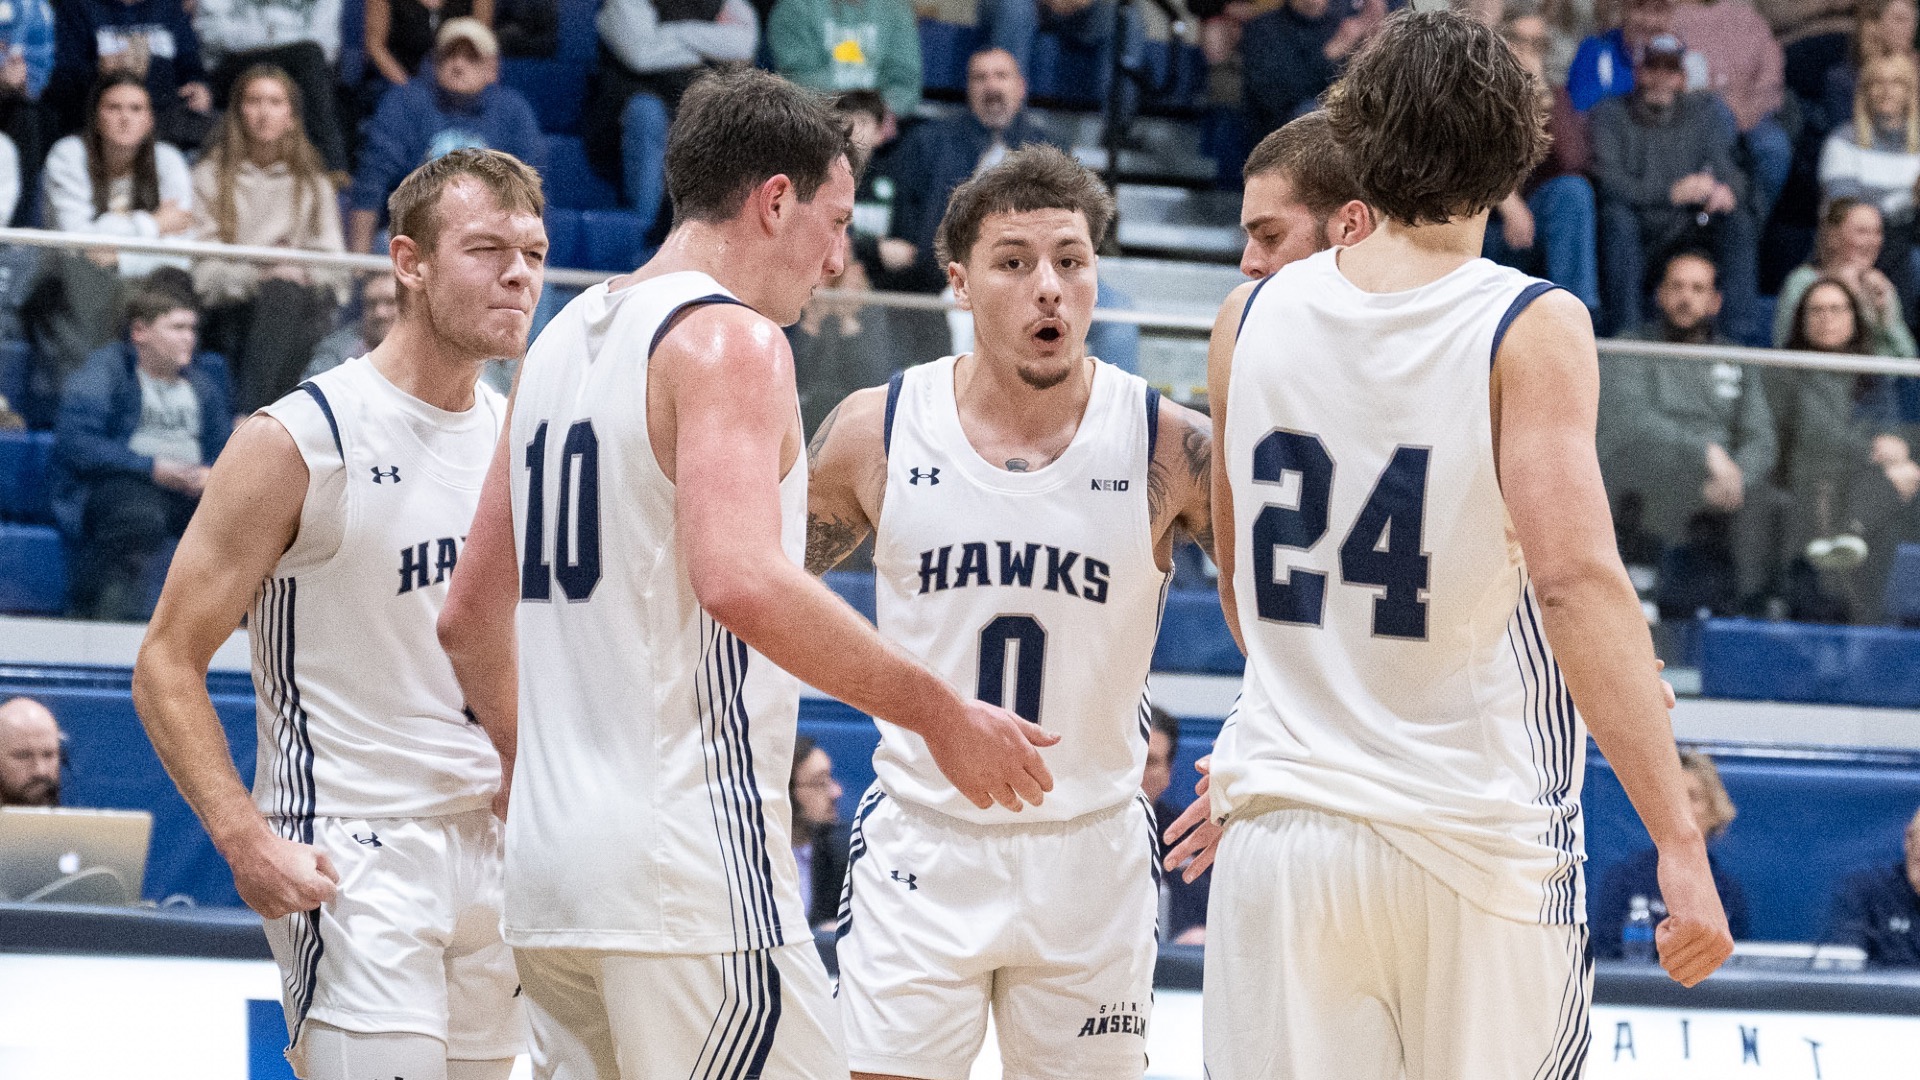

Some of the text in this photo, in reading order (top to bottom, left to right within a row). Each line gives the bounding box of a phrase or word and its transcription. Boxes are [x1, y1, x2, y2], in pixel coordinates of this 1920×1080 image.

[521, 417, 603, 604] 10
[1091, 478, 1129, 491] NE10
[396, 536, 466, 596] HA
[918, 541, 1111, 604] HAWKS
[1252, 426, 1433, 642] 24
[974, 612, 1048, 726] 0
